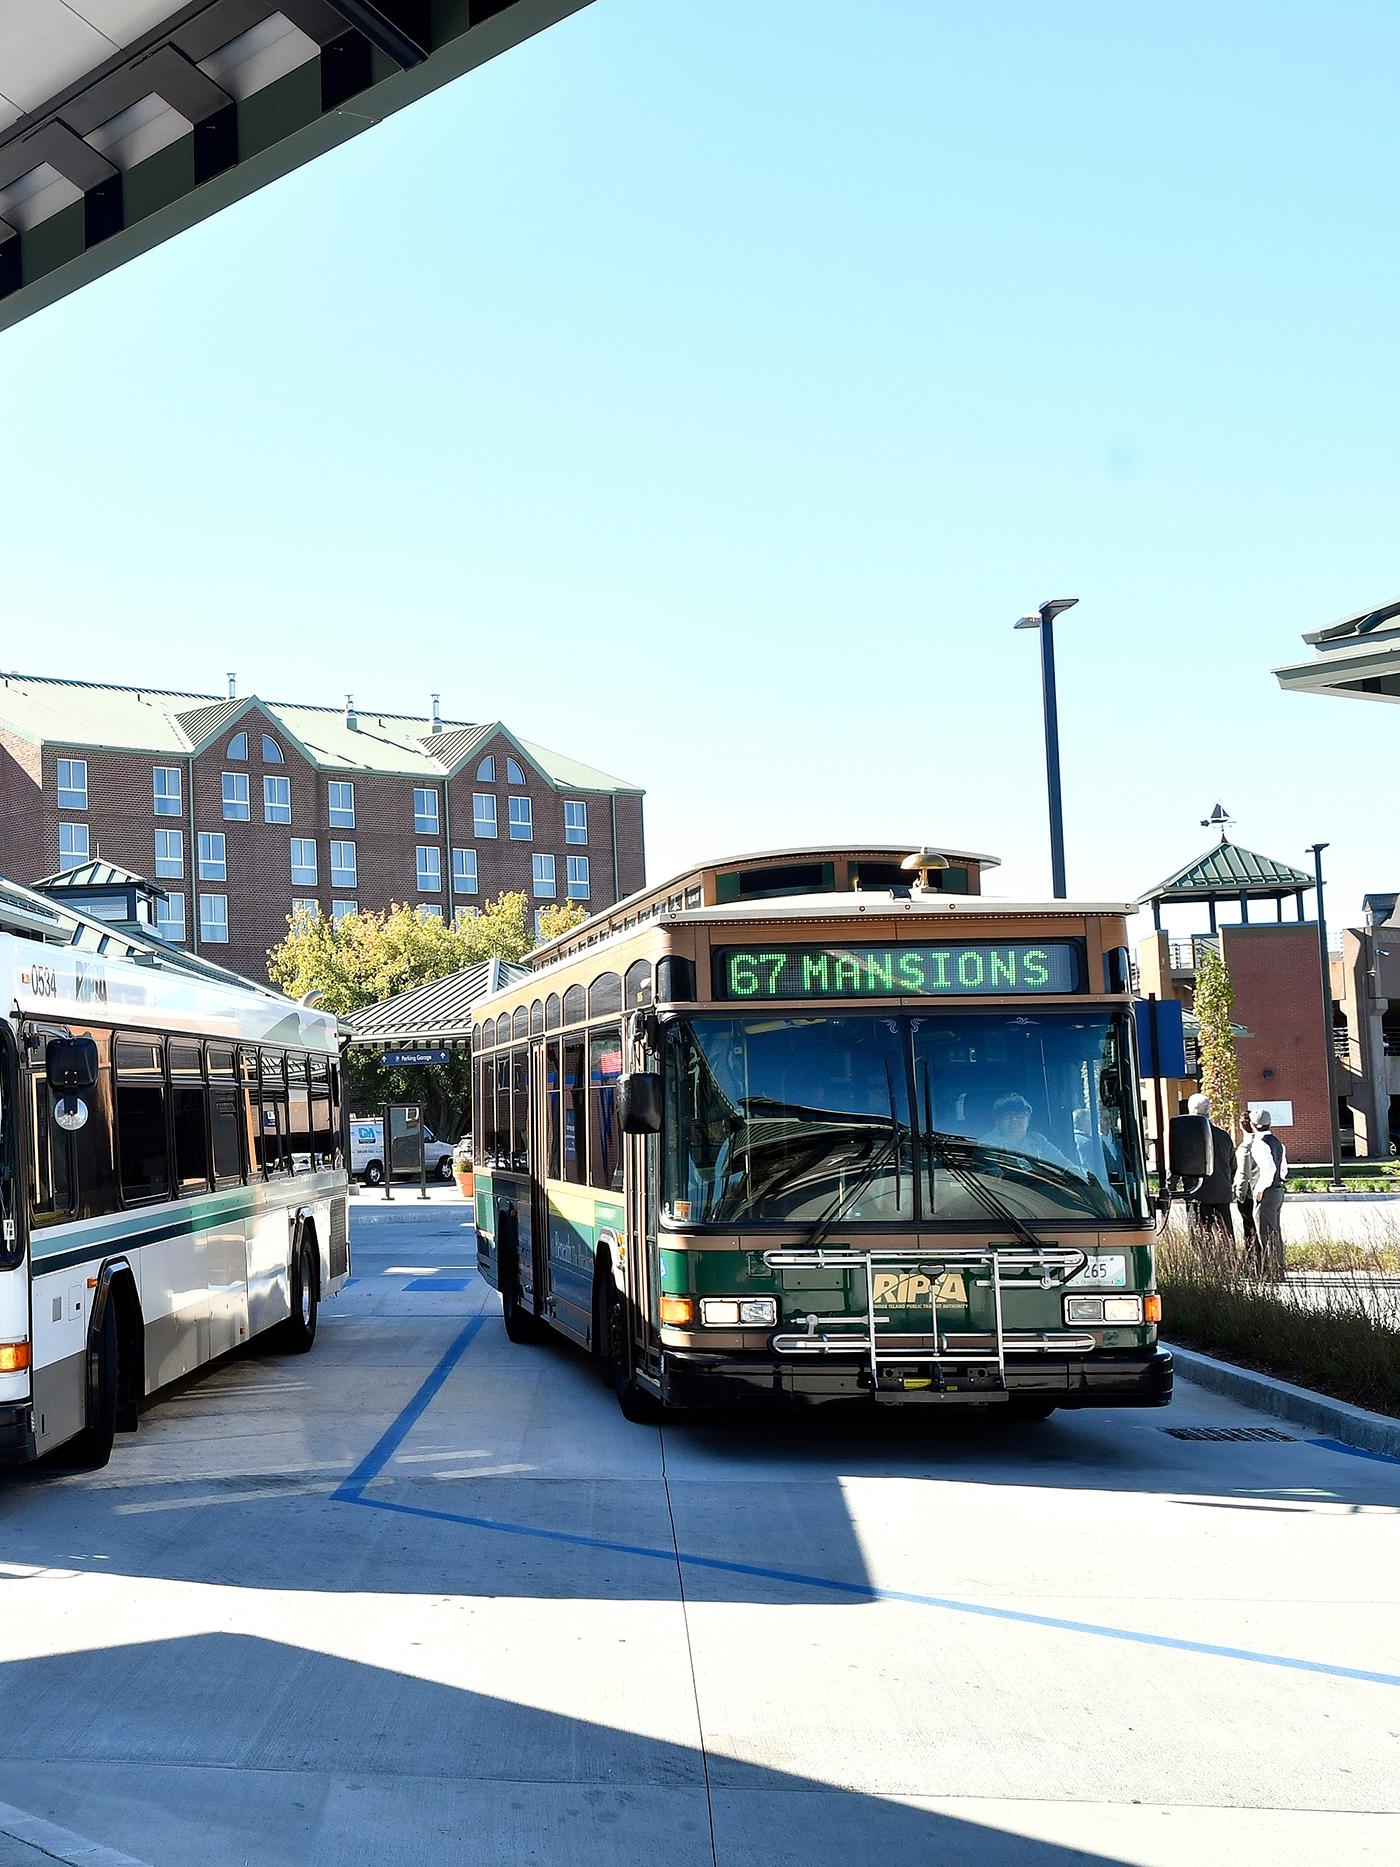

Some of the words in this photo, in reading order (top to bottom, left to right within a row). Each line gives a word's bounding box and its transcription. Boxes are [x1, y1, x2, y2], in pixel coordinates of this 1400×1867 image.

[31, 964, 57, 998] 0534
[730, 954, 787, 995] 67
[803, 950, 1049, 991] MANSIONS
[416, 1054, 432, 1062] Garage
